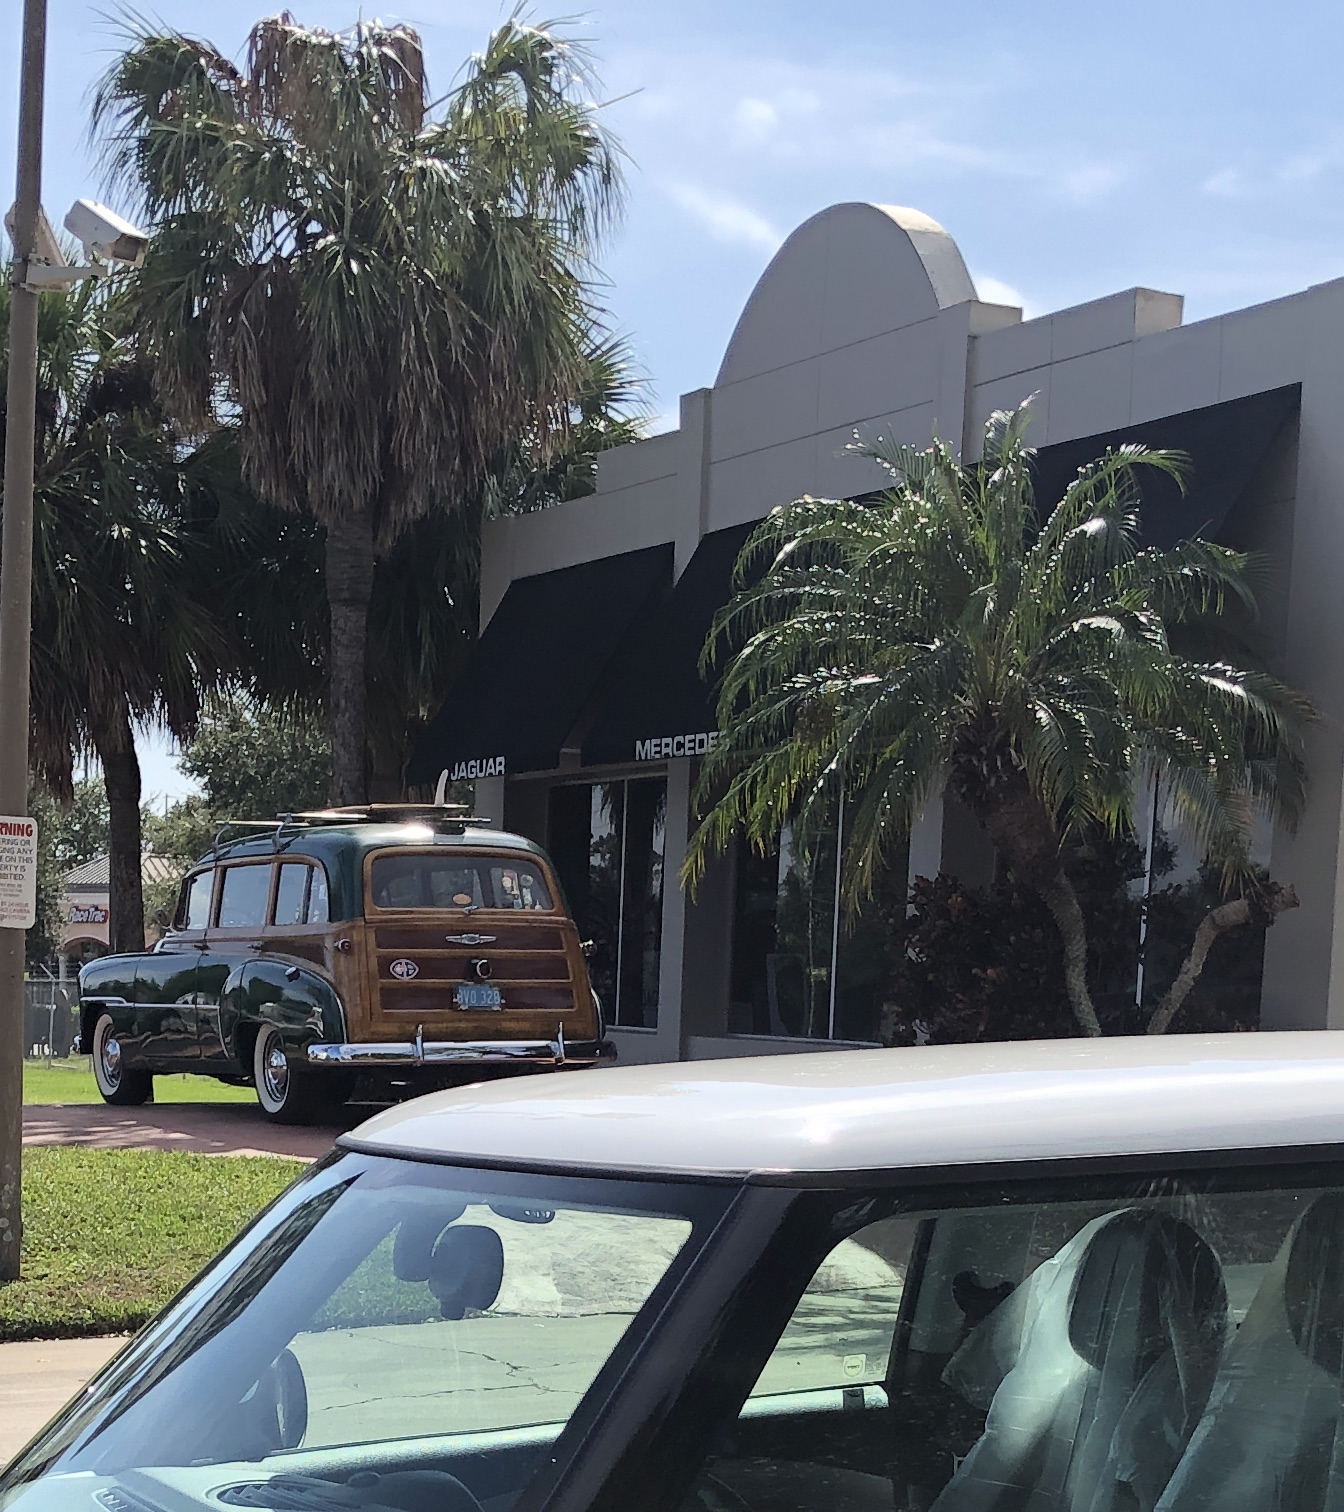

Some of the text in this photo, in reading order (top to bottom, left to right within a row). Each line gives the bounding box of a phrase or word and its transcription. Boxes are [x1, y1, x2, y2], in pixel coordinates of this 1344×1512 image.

[449, 756, 506, 781] JAGUAR
[17, 847, 33, 855] ANY
[5, 855, 16, 863] ON
